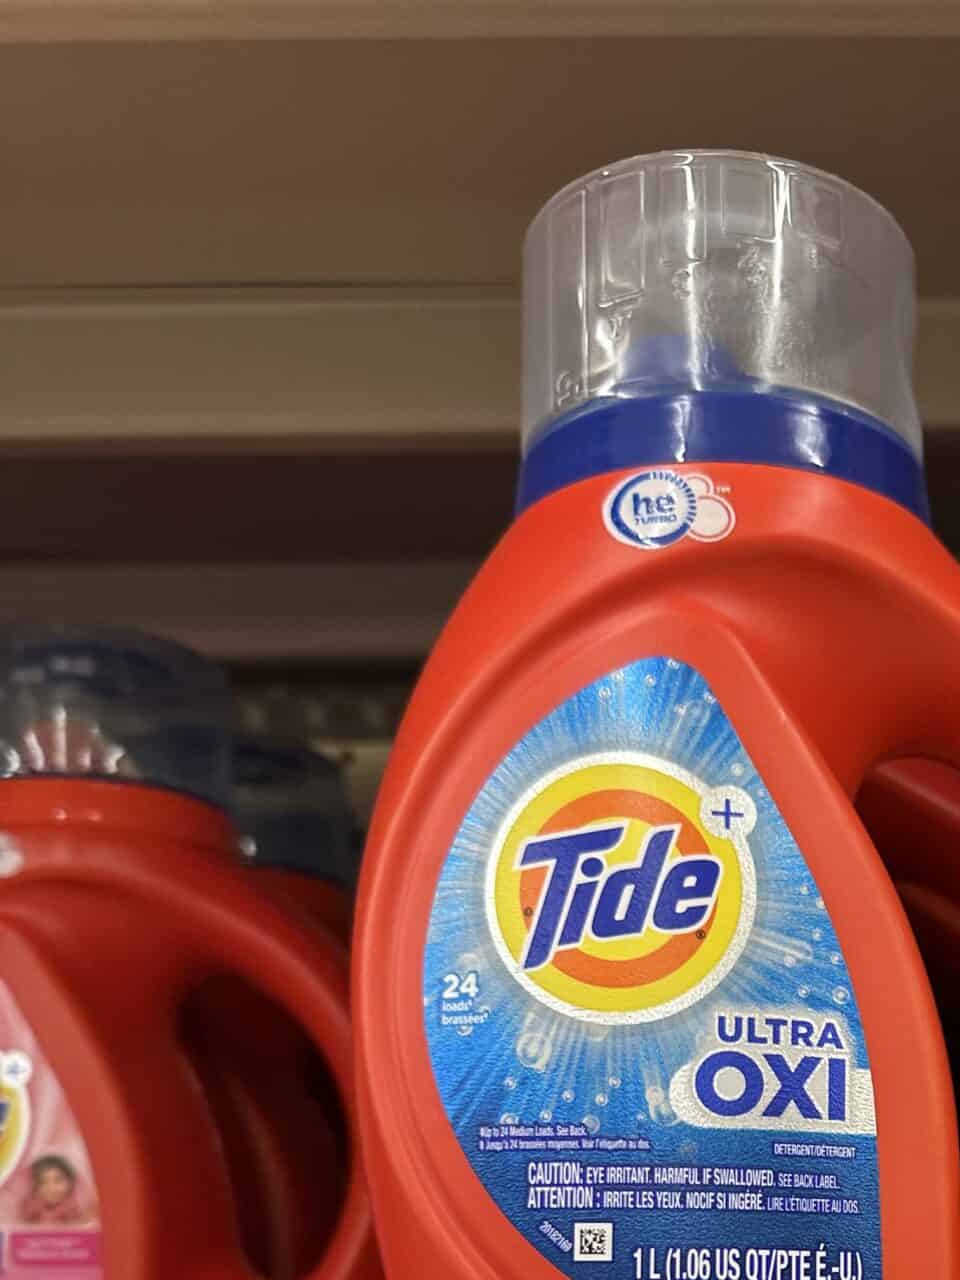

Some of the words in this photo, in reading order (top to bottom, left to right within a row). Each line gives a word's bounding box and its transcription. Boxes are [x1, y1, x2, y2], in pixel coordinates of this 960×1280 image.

[633, 493, 675, 516] he
[520, 827, 720, 969] Tide
[443, 973, 479, 998] 24
[718, 1016, 844, 1049] ULTRA
[695, 1051, 845, 1120] OXI
[528, 1162, 583, 1185] CAUTION:
[586, 1167, 604, 1185] EYE
[606, 1167, 652, 1185] IRRITANT.
[654, 1168, 701, 1185] HARMFUL
[703, 1168, 712, 1185] IF
[713, 1168, 776, 1187] SWALLOWED.
[778, 1173, 792, 1188] SEE
[793, 1174, 814, 1188] BACK
[815, 1175, 840, 1190] LABEL.
[528, 1187, 593, 1209] ATTENTION
[603, 1192, 634, 1209] IRRITE
[636, 1192, 654, 1209] LES
[656, 1192, 684, 1209] YEUX.
[686, 1192, 714, 1210] NOCIF
[716, 1192, 726, 1210] SI
[728, 1189, 765, 1211] INGÉRÉ.
[767, 1197, 784, 1211] LIRE
[831, 1199, 841, 1213] AU
[634, 1248, 641, 1279] 1
[649, 1248, 660, 1279] L
[716, 1248, 740, 1280] US
